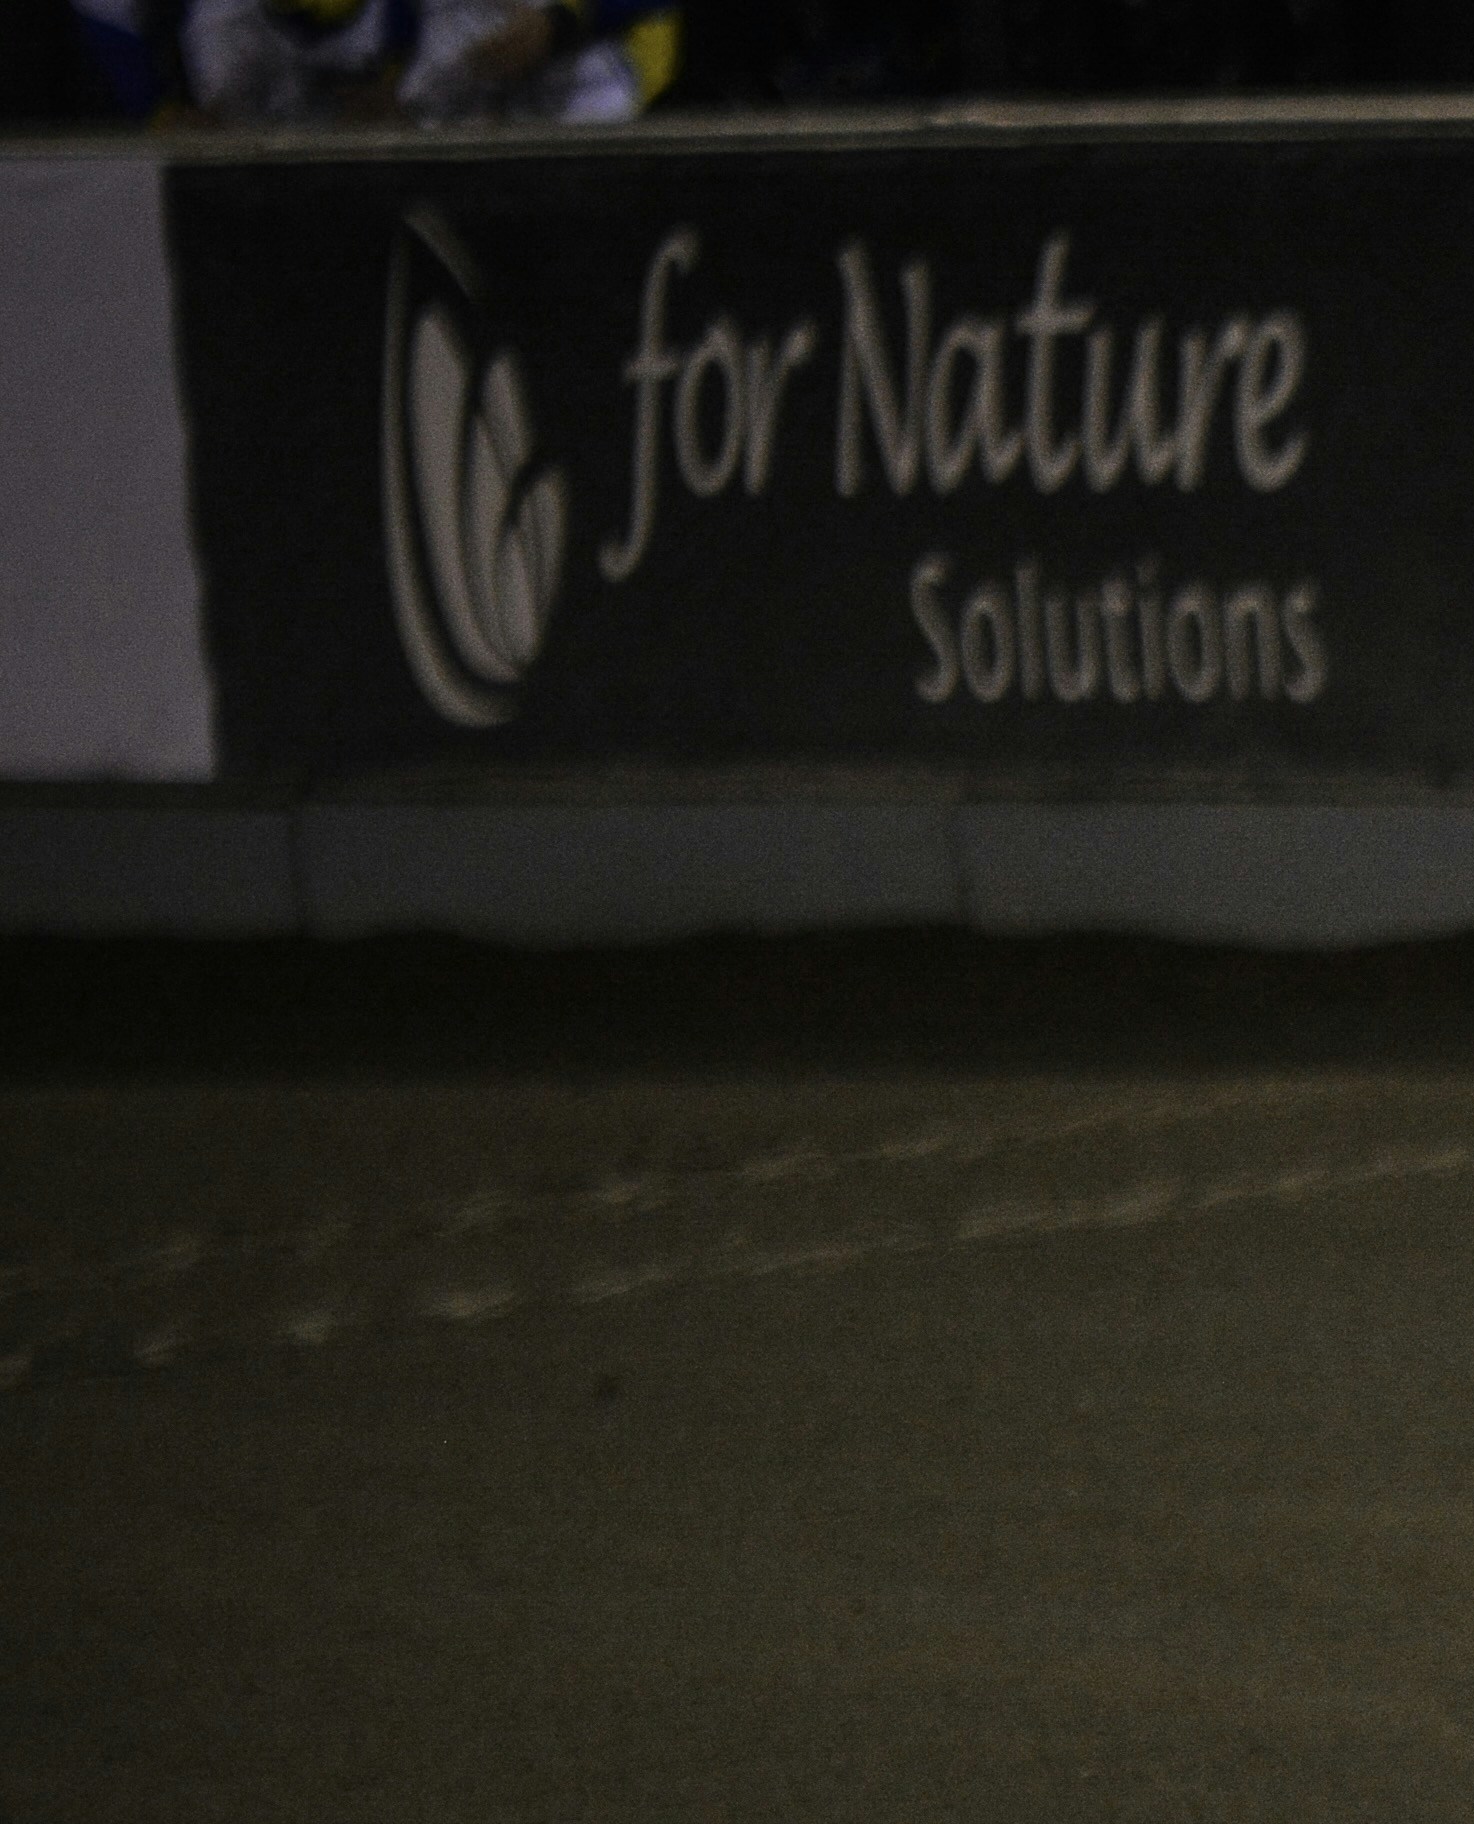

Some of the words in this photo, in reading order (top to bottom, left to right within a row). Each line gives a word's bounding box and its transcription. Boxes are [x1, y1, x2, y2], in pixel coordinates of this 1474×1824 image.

[598, 228, 813, 582] for
[834, 230, 1311, 498] Nature
[910, 549, 1329, 706] Solutions
